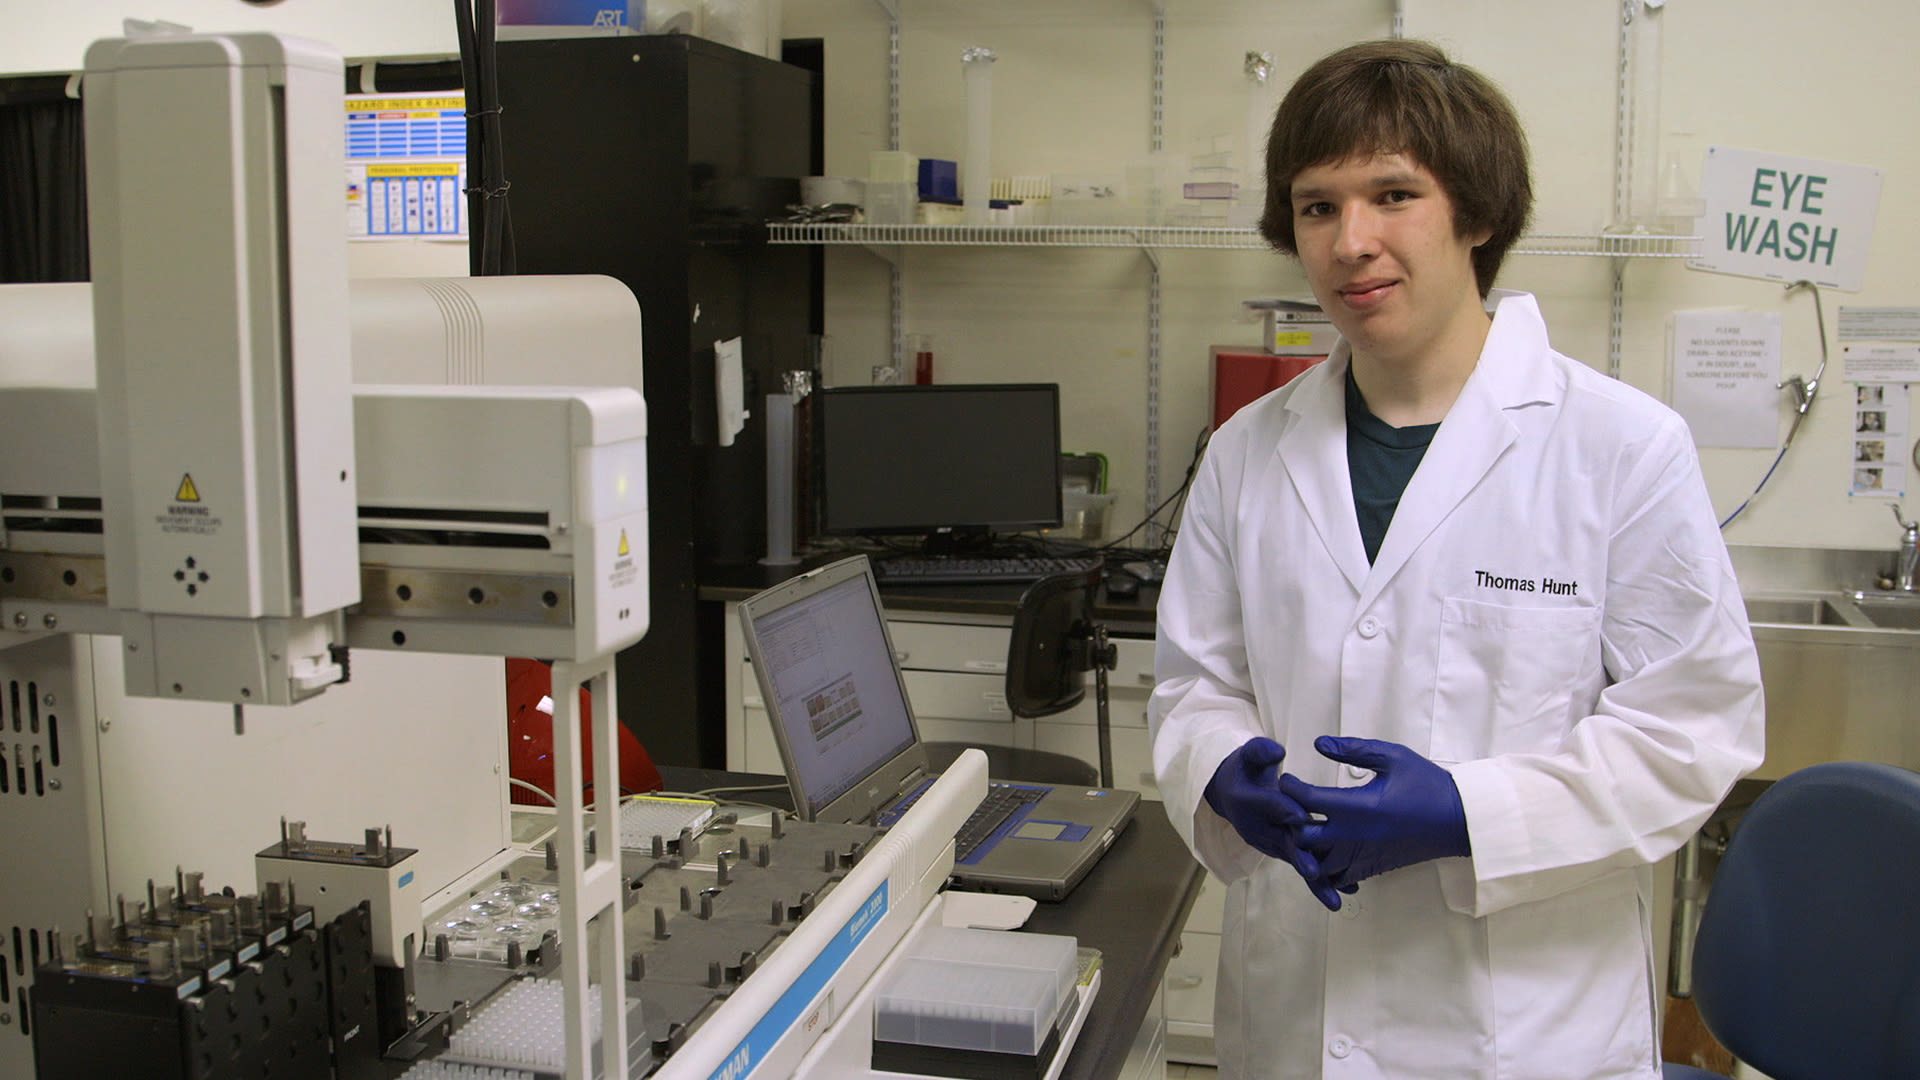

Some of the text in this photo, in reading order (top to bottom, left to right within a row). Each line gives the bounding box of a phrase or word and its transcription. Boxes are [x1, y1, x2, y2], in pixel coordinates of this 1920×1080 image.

[593, 9, 624, 27] ART
[1751, 167, 1828, 215] EYE
[1726, 211, 1839, 266] WASH
[1690, 338, 1765, 347] NO SOLVENTS DOWN
[167, 506, 209, 516] WARNING
[1475, 570, 1578, 596] Thomas Hunt
